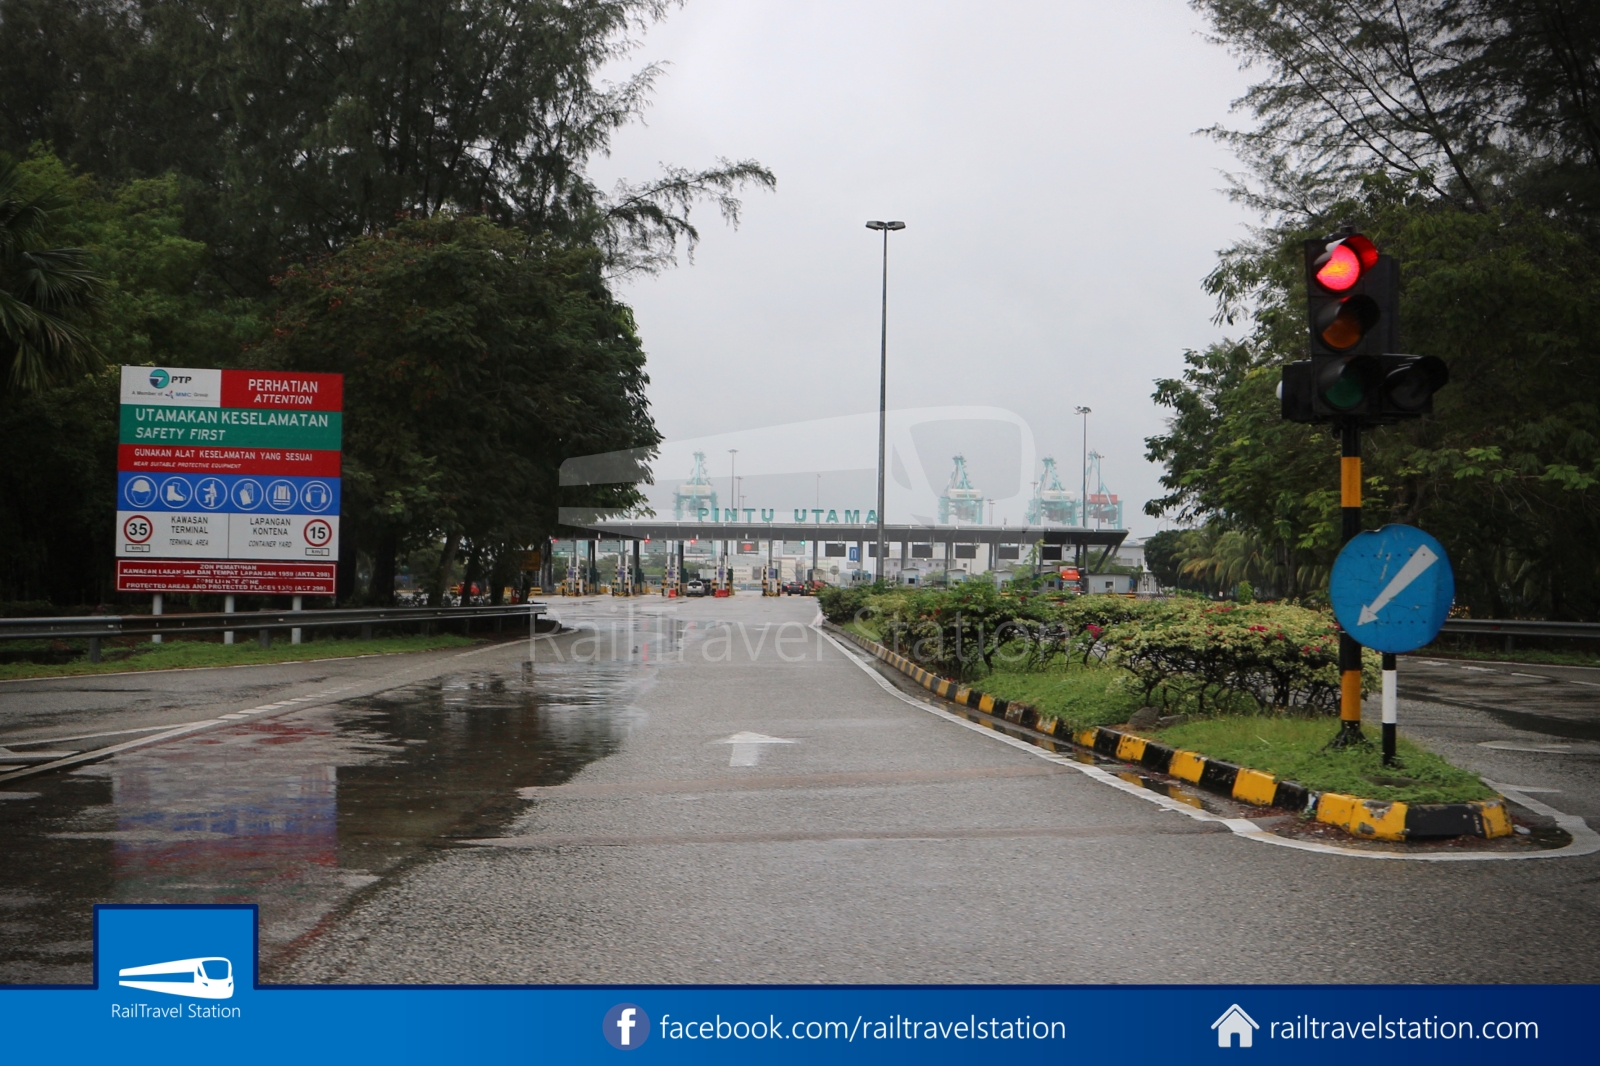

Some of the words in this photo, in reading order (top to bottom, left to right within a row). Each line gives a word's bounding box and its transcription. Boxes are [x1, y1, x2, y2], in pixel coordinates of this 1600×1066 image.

[171, 376, 192, 384] PTP
[248, 378, 318, 393] PERHATIAN
[254, 394, 312, 404] ATTENTION
[135, 408, 218, 424] UTAMAKAN
[222, 410, 328, 427] KESELAMATAN
[135, 427, 185, 439] SAFETY
[190, 429, 226, 441] FIRST
[135, 448, 171, 457] GUNAKAN
[175, 450, 195, 458] ALAT
[199, 450, 255, 459] KESELAMATAN
[260, 452, 281, 461] YANG
[285, 453, 312, 461] SESUAI
[171, 516, 208, 524] KAWASAN
[250, 518, 290, 526] LAPANGAN
[698, 508, 774, 523] PINTU
[794, 509, 879, 524] UTAMA
[129, 523, 147, 536] 35
[171, 526, 208, 534] TERMINAL
[310, 527, 326, 539] 15
